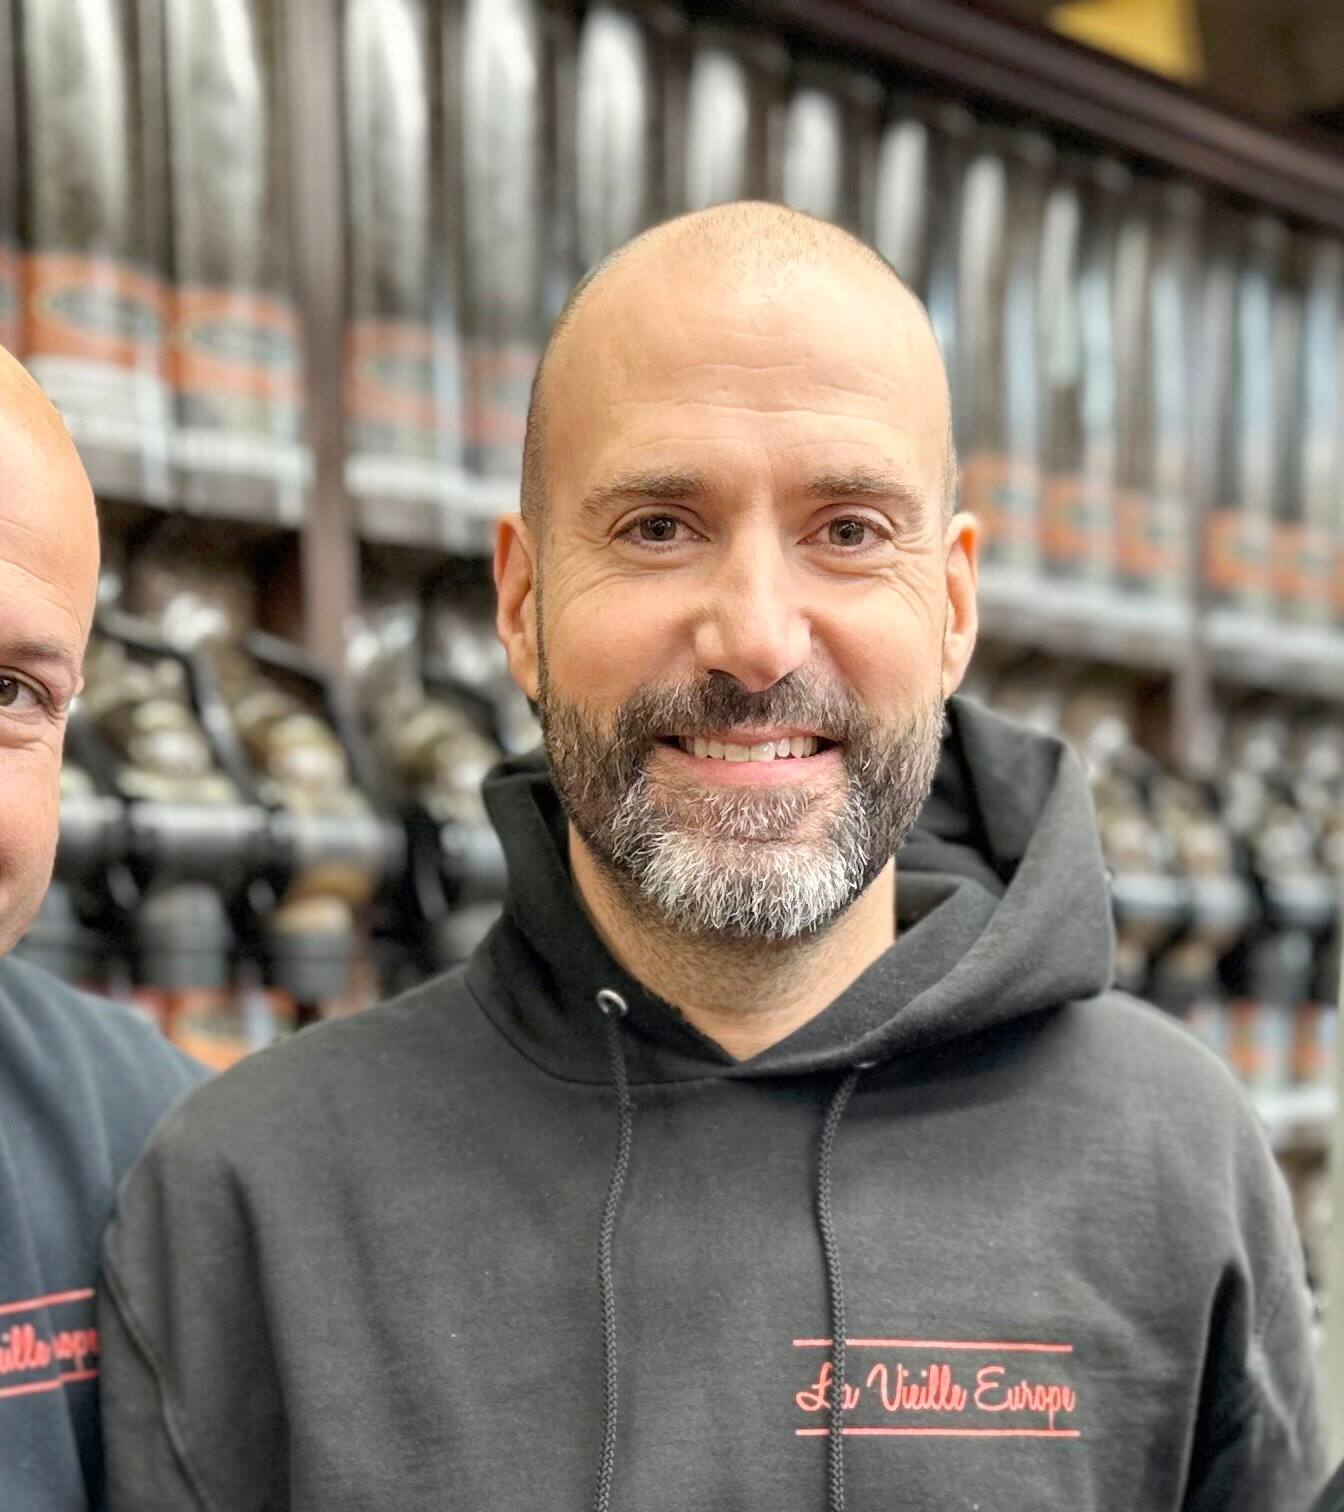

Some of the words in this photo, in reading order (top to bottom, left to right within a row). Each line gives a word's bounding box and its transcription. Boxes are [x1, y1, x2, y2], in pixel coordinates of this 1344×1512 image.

[795, 1361, 861, 1412] La
[866, 1363, 967, 1412] Vieille
[974, 1366, 1076, 1431] Europe
